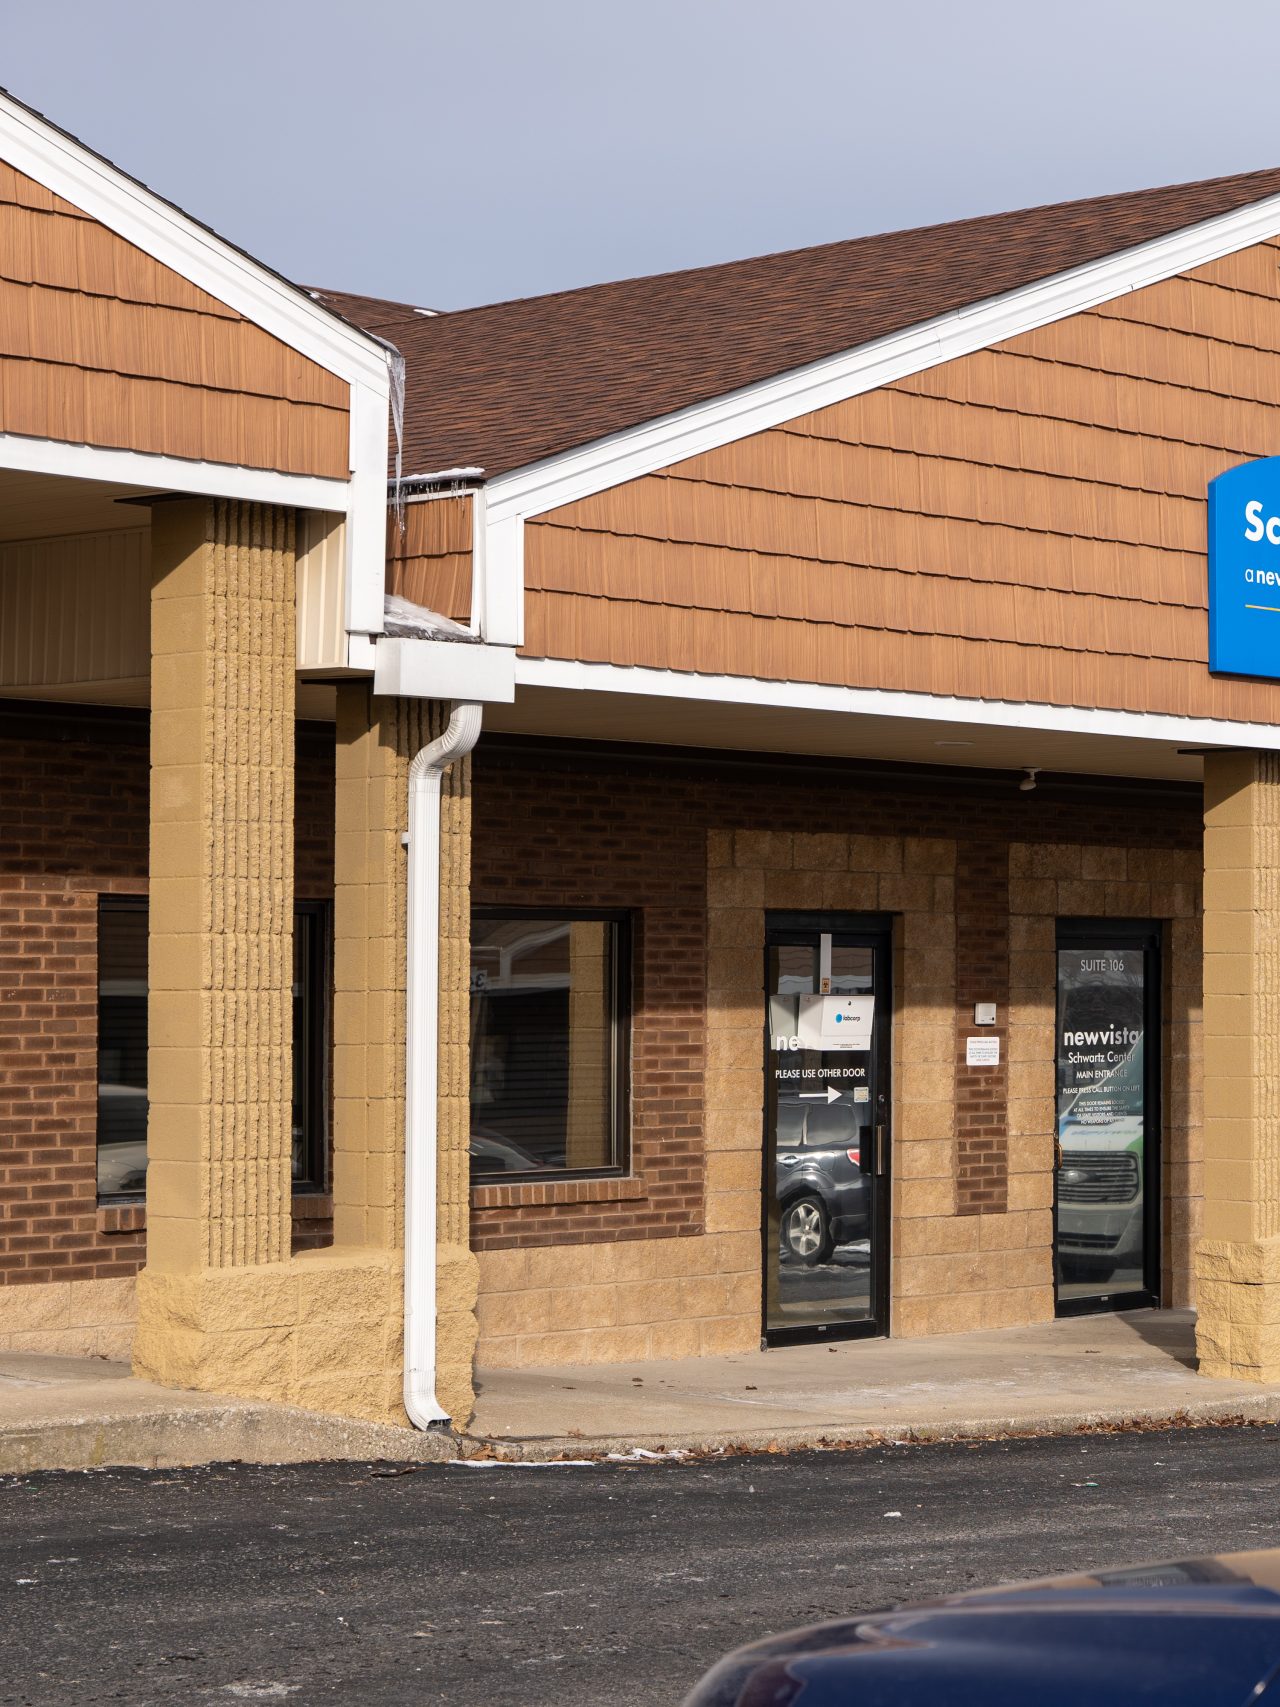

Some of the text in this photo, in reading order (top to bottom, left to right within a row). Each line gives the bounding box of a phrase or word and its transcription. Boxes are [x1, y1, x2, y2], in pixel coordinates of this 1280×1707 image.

[1245, 568, 1254, 583] a
[1080, 959, 1125, 972] SUITE 106
[1063, 1023, 1140, 1046] newvista
[1068, 1051, 1135, 1063] Schwartz Center
[775, 1068, 866, 1079] PLEASE USE OTHER DOOR
[1076, 1069, 1128, 1079] MAIN ENTRANCE
[1079, 1086, 1092, 1094] PRESS
